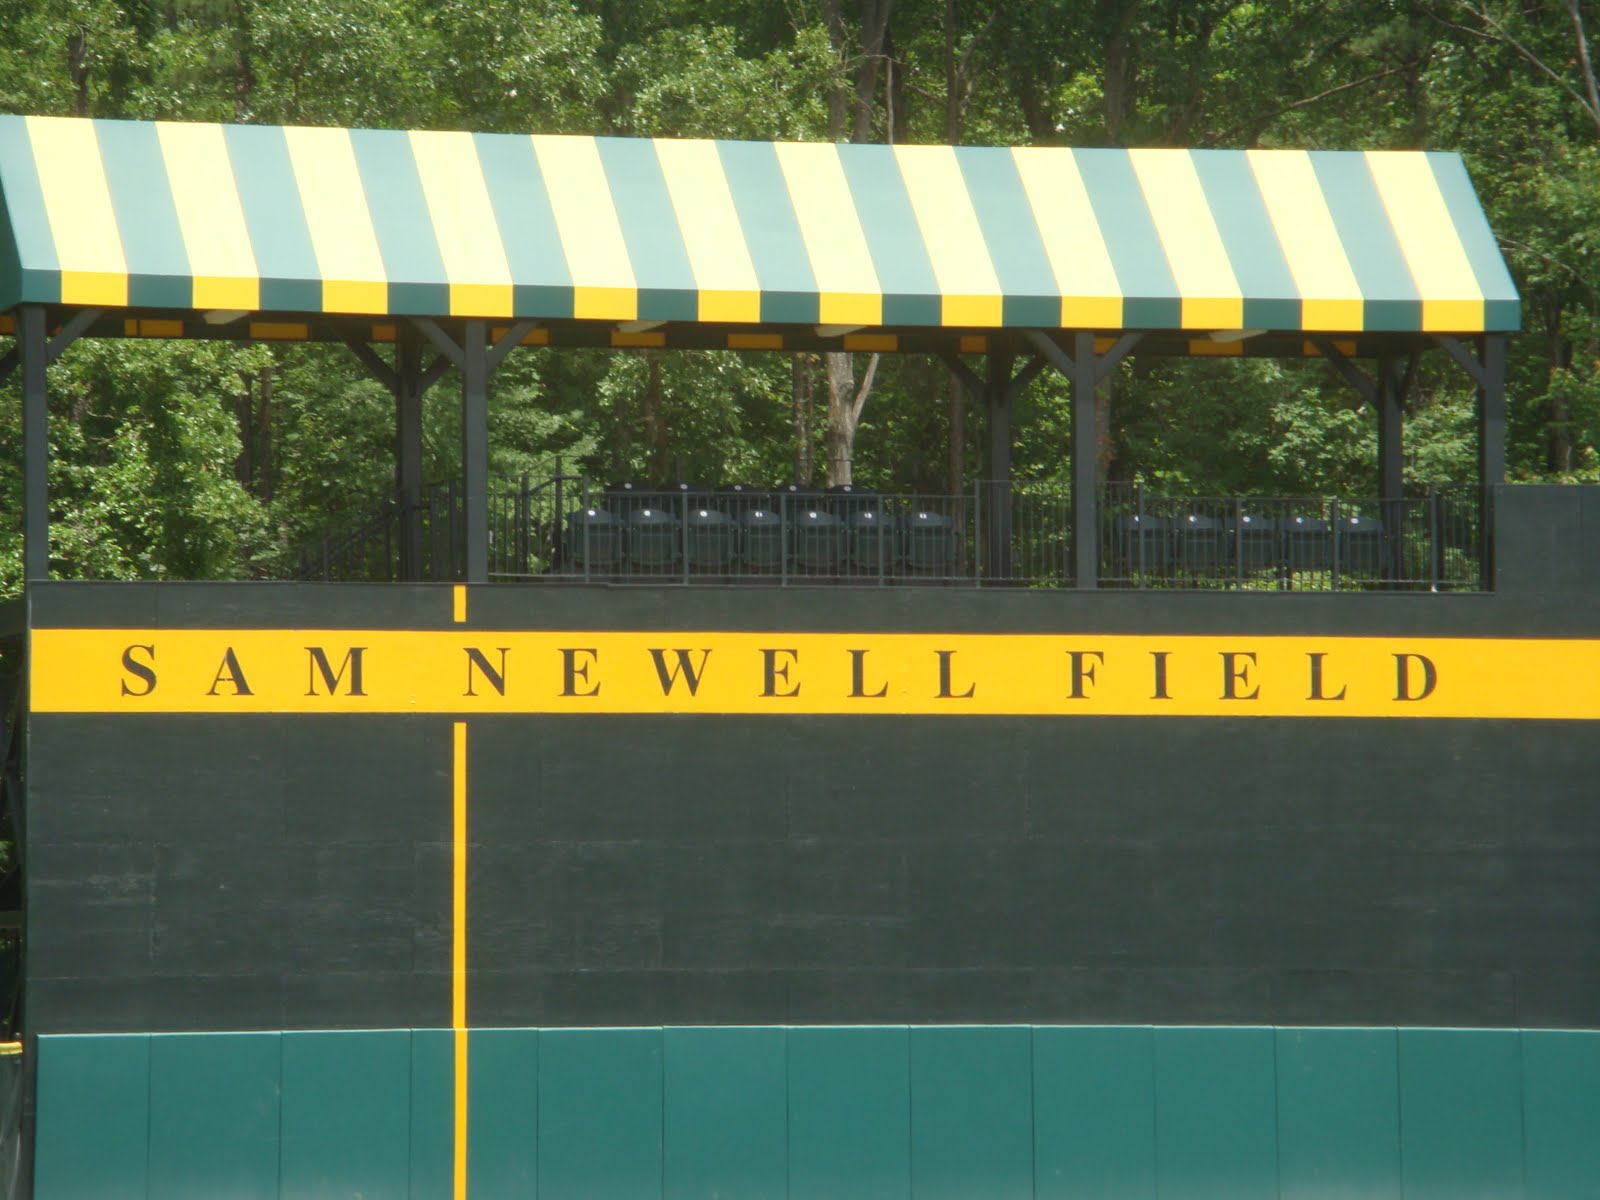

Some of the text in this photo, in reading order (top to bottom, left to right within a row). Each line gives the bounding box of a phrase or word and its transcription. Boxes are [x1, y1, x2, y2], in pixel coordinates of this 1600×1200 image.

[120, 644, 1439, 702] SAM NEWELL FIELD
